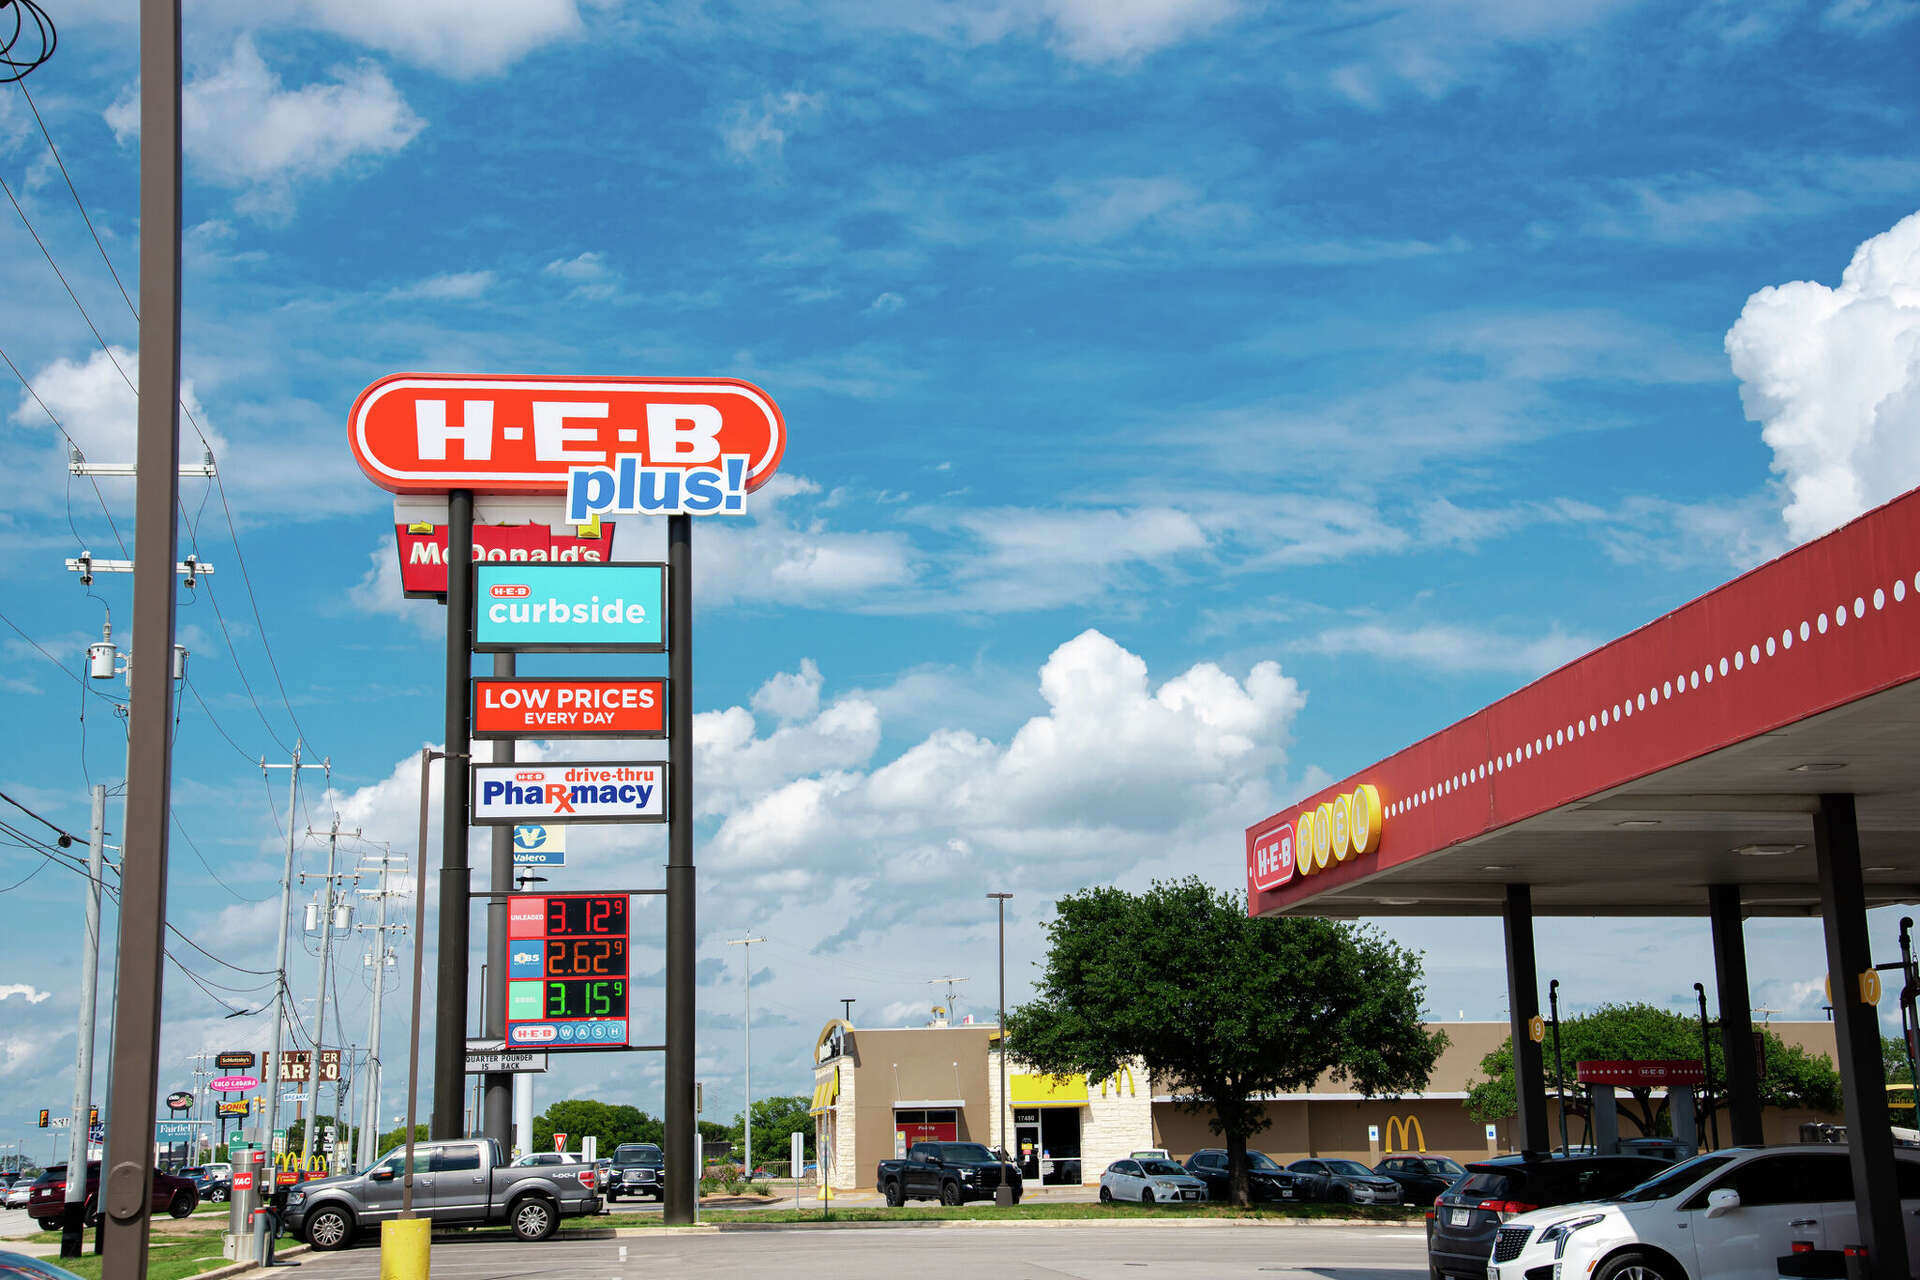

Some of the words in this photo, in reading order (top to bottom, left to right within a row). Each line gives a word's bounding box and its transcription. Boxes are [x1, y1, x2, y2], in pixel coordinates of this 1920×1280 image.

[415, 399, 723, 463] H-E-B
[567, 455, 748, 523] plus!
[488, 596, 646, 624] curbside
[485, 689, 550, 708] LOW
[557, 688, 655, 708] PRICES
[524, 712, 578, 724] EVERY
[583, 711, 615, 724] DAY
[564, 768, 654, 782] drive-thru
[514, 854, 546, 862] Valero
[1867, 978, 1874, 996] 7
[1535, 1022, 1541, 1036] 9
[466, 1055, 499, 1063] QUARTER
[501, 1054, 533, 1062] POUNDER
[501, 1062, 519, 1070] BACK
[222, 1102, 247, 1112] SONIC
[234, 1177, 251, 1185] VAC
